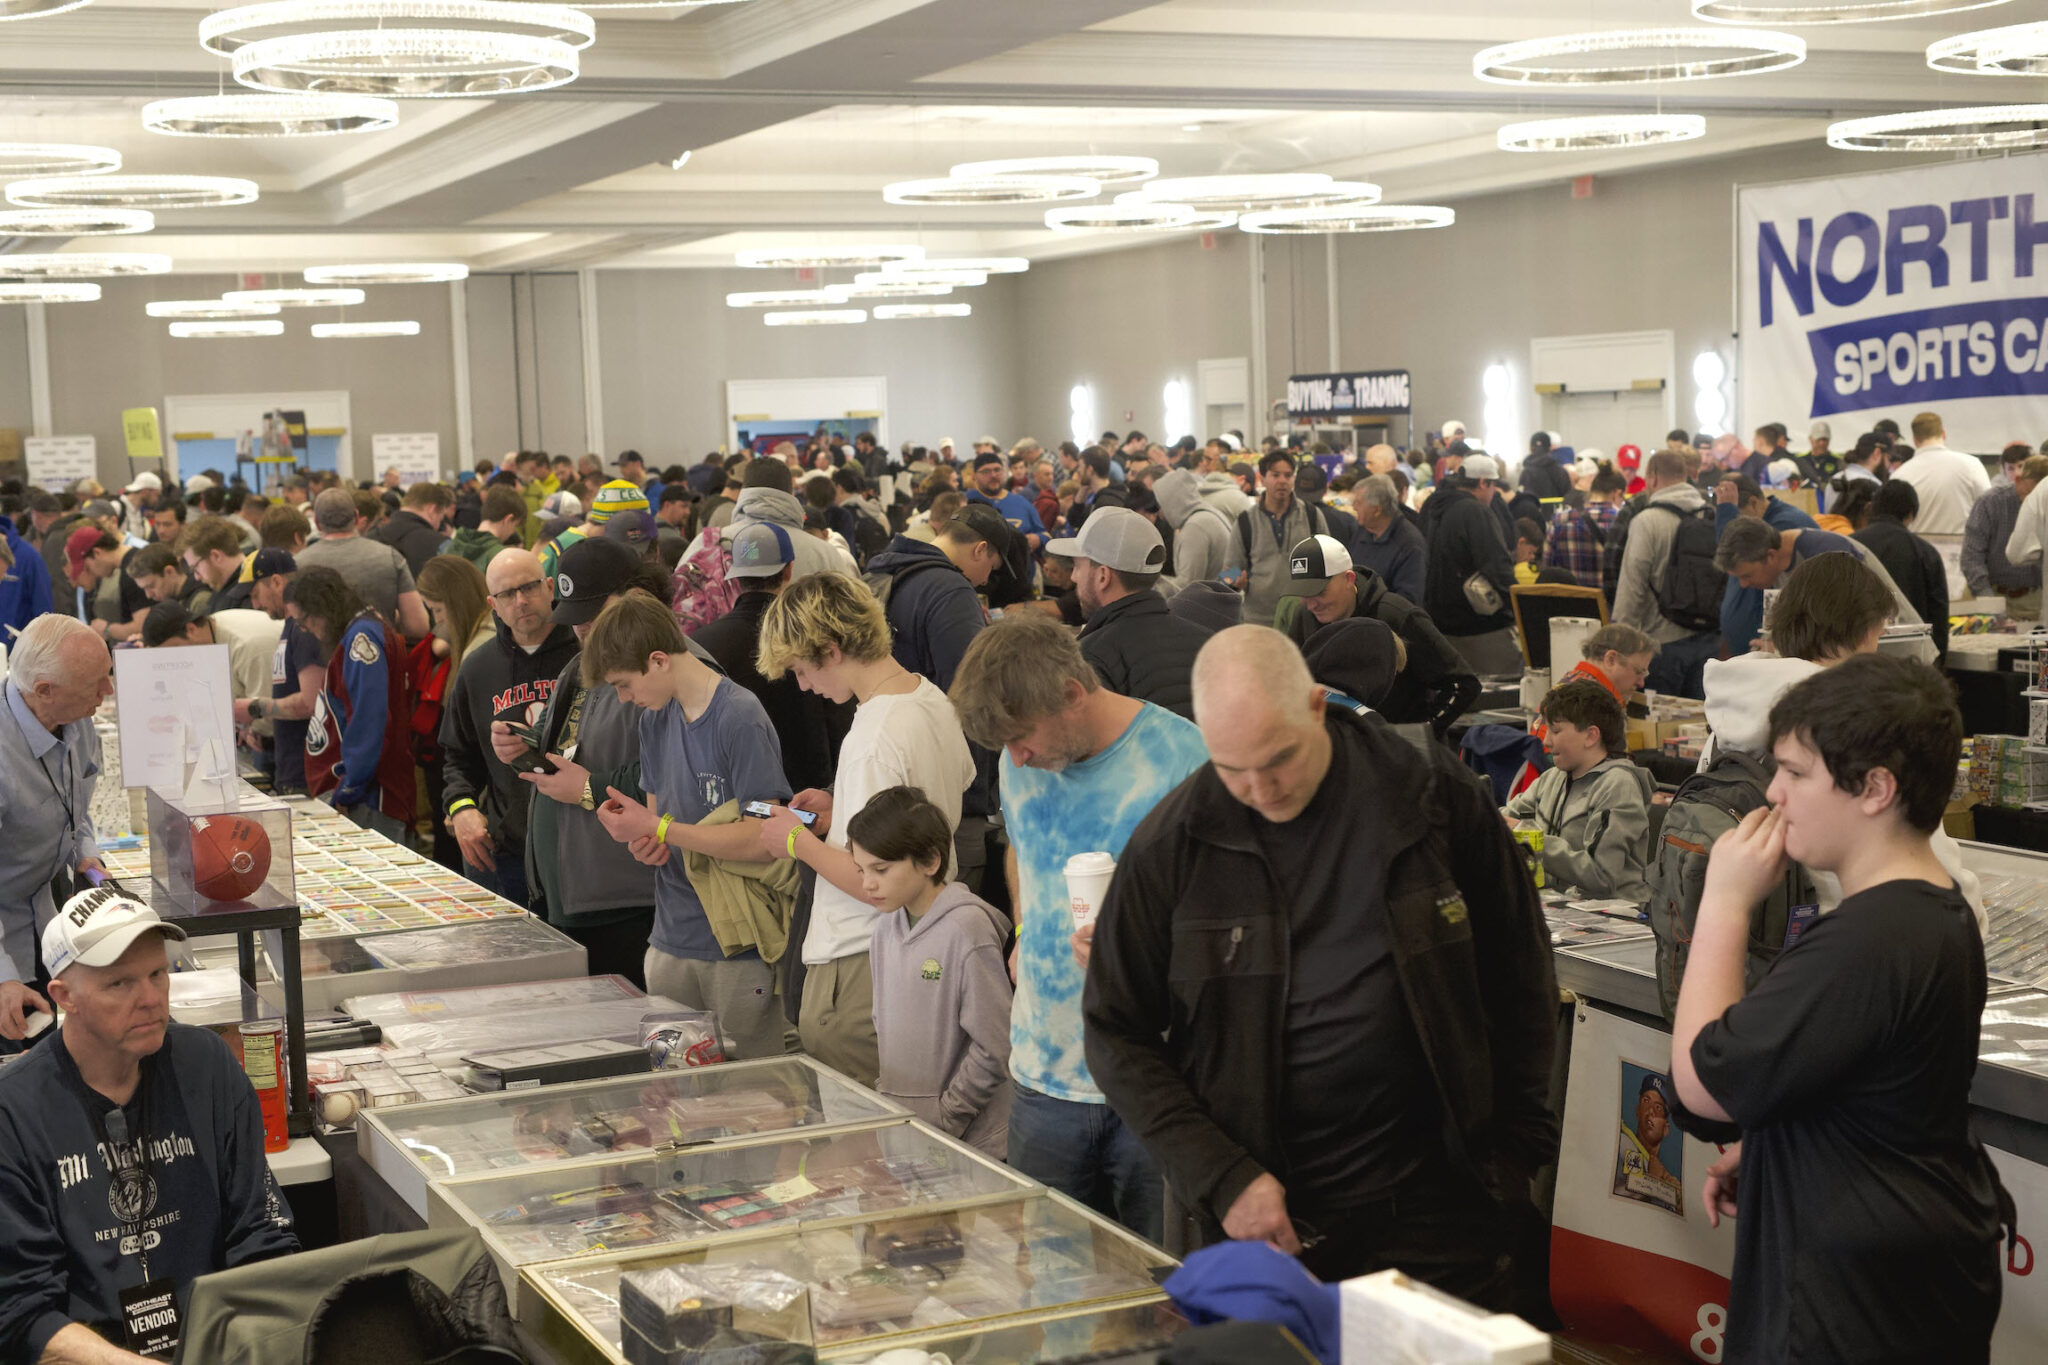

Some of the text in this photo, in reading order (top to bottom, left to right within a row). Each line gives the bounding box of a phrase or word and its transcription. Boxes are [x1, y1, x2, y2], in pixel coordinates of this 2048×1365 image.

[1758, 193, 2048, 328] NORTH
[1834, 321, 1996, 395] SPORTS
[1288, 374, 1409, 411] BUYING TRADING
[57, 1152, 93, 1192] Mt.
[95, 1227, 119, 1242] NEW
[125, 1293, 172, 1313] NORTHEAST
[129, 1308, 176, 1334] VENDOR
